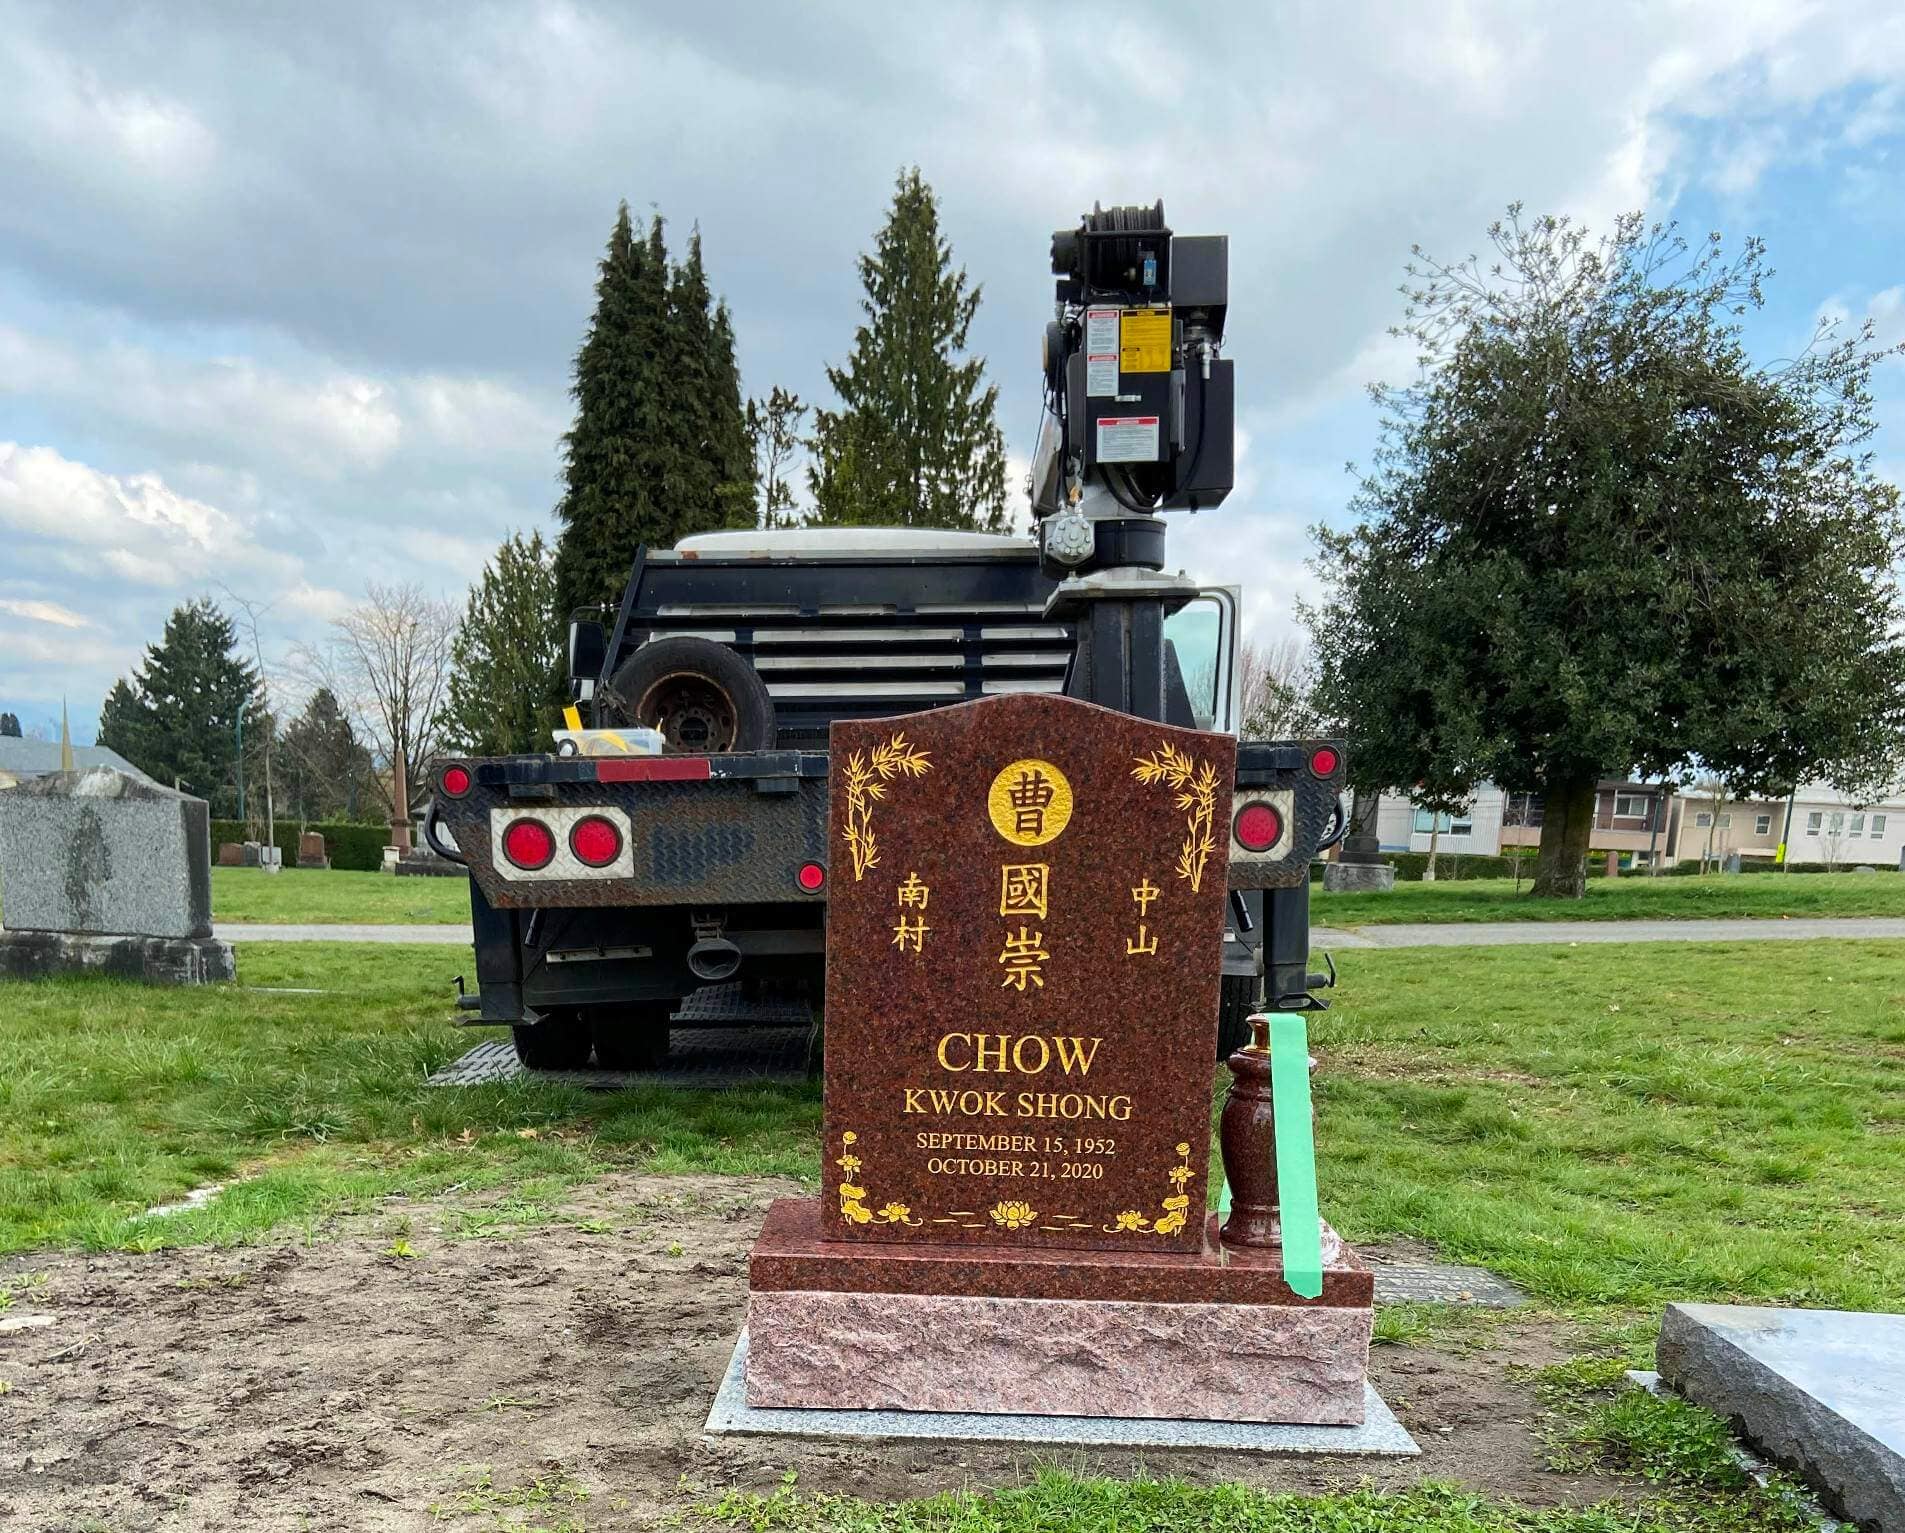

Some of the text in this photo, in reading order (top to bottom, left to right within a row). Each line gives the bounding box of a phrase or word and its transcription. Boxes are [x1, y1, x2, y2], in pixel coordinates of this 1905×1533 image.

[1007, 768, 1055, 838] 曹
[891, 871, 932, 955] 南村
[1125, 877, 1162, 957] 中山
[936, 1032, 1104, 1076] CHOW
[902, 1088, 1133, 1121] KWOK SHONG
[916, 1132, 1116, 1157] SEPTEMBER 15, 1952
[927, 1157, 1104, 1181] OCTOBER 21, 2020
